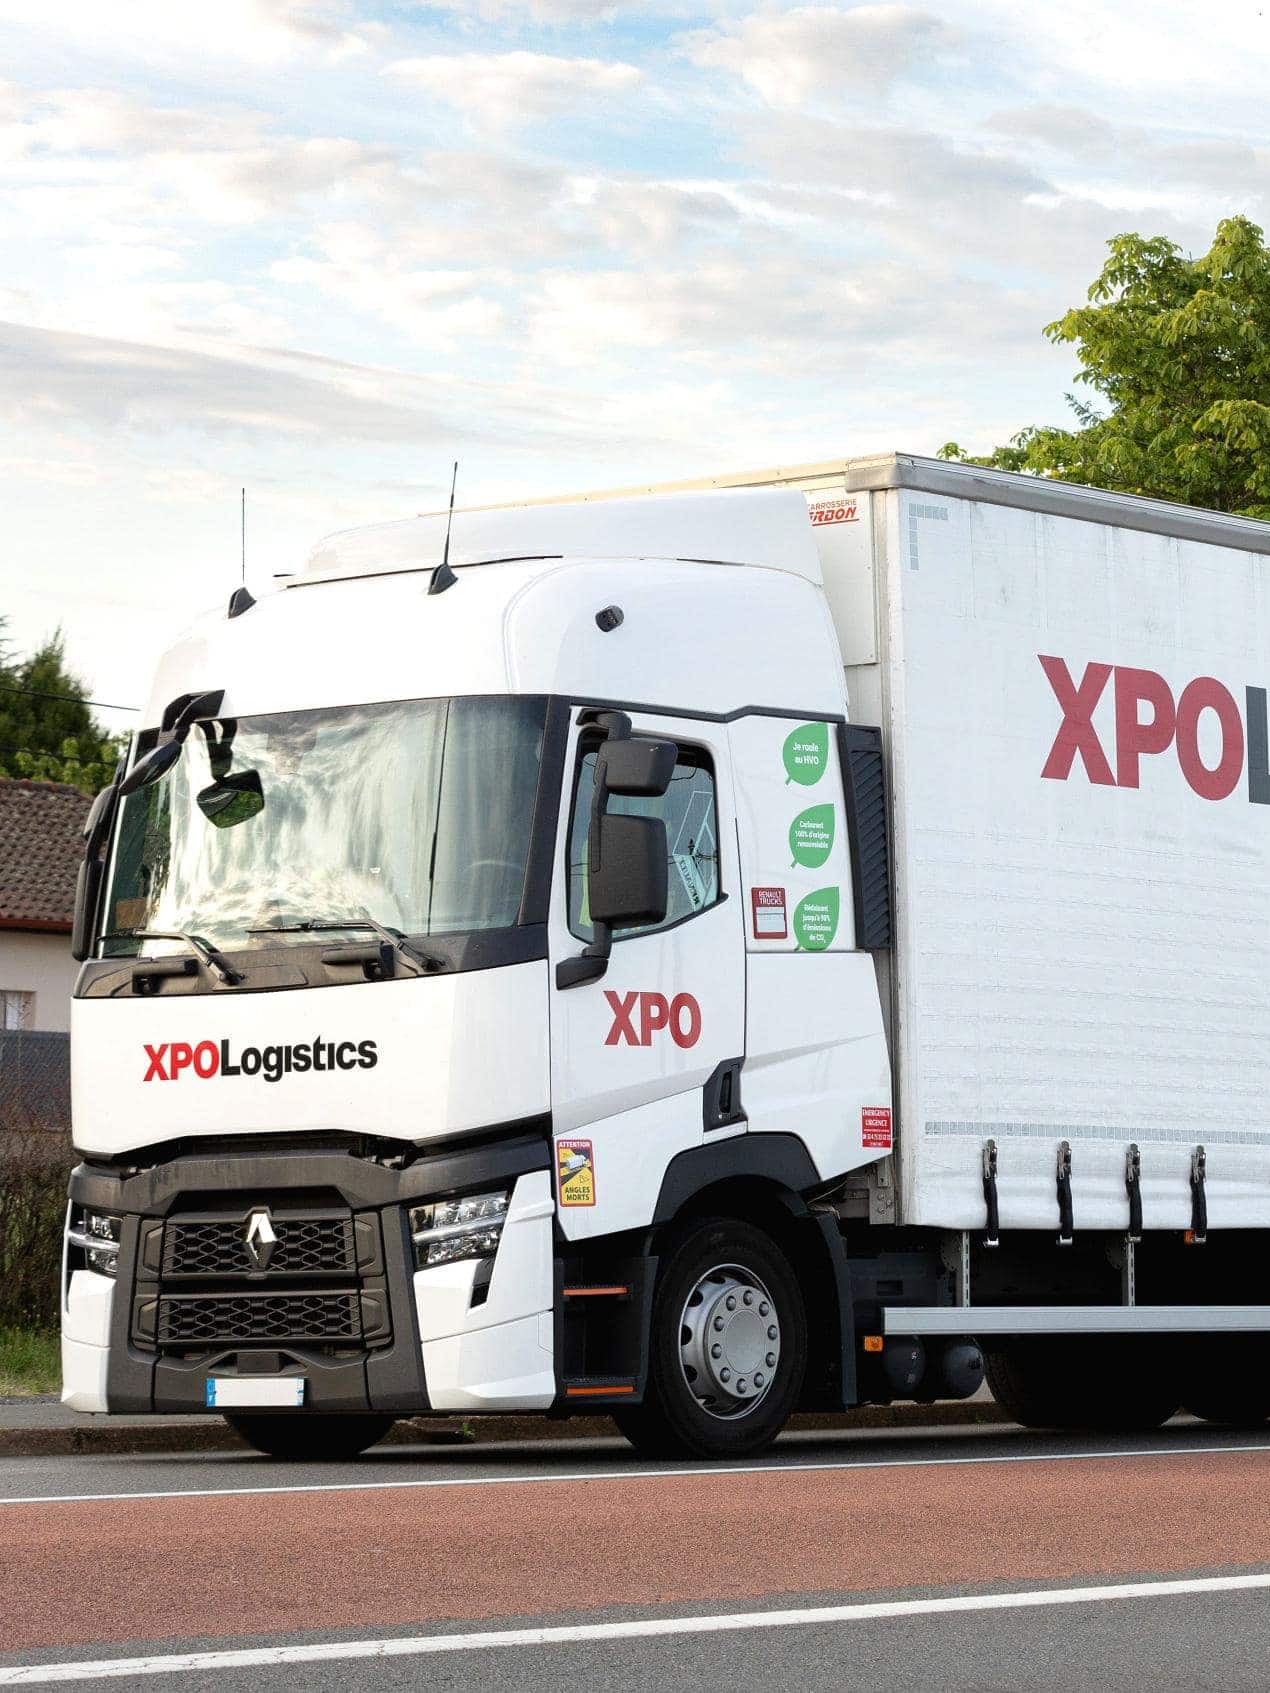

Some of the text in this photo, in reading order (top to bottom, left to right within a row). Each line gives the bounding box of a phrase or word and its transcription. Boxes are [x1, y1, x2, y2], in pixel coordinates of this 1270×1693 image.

[808, 499, 856, 510] ARROSSERIE
[804, 755, 819, 765] HVO
[759, 890, 782, 899] RENAULT
[603, 990, 701, 1049] XPO
[865, 1119, 888, 1127] URGENCE
[565, 1186, 591, 1194] ANGLES
[566, 1193, 590, 1201] MORTS
